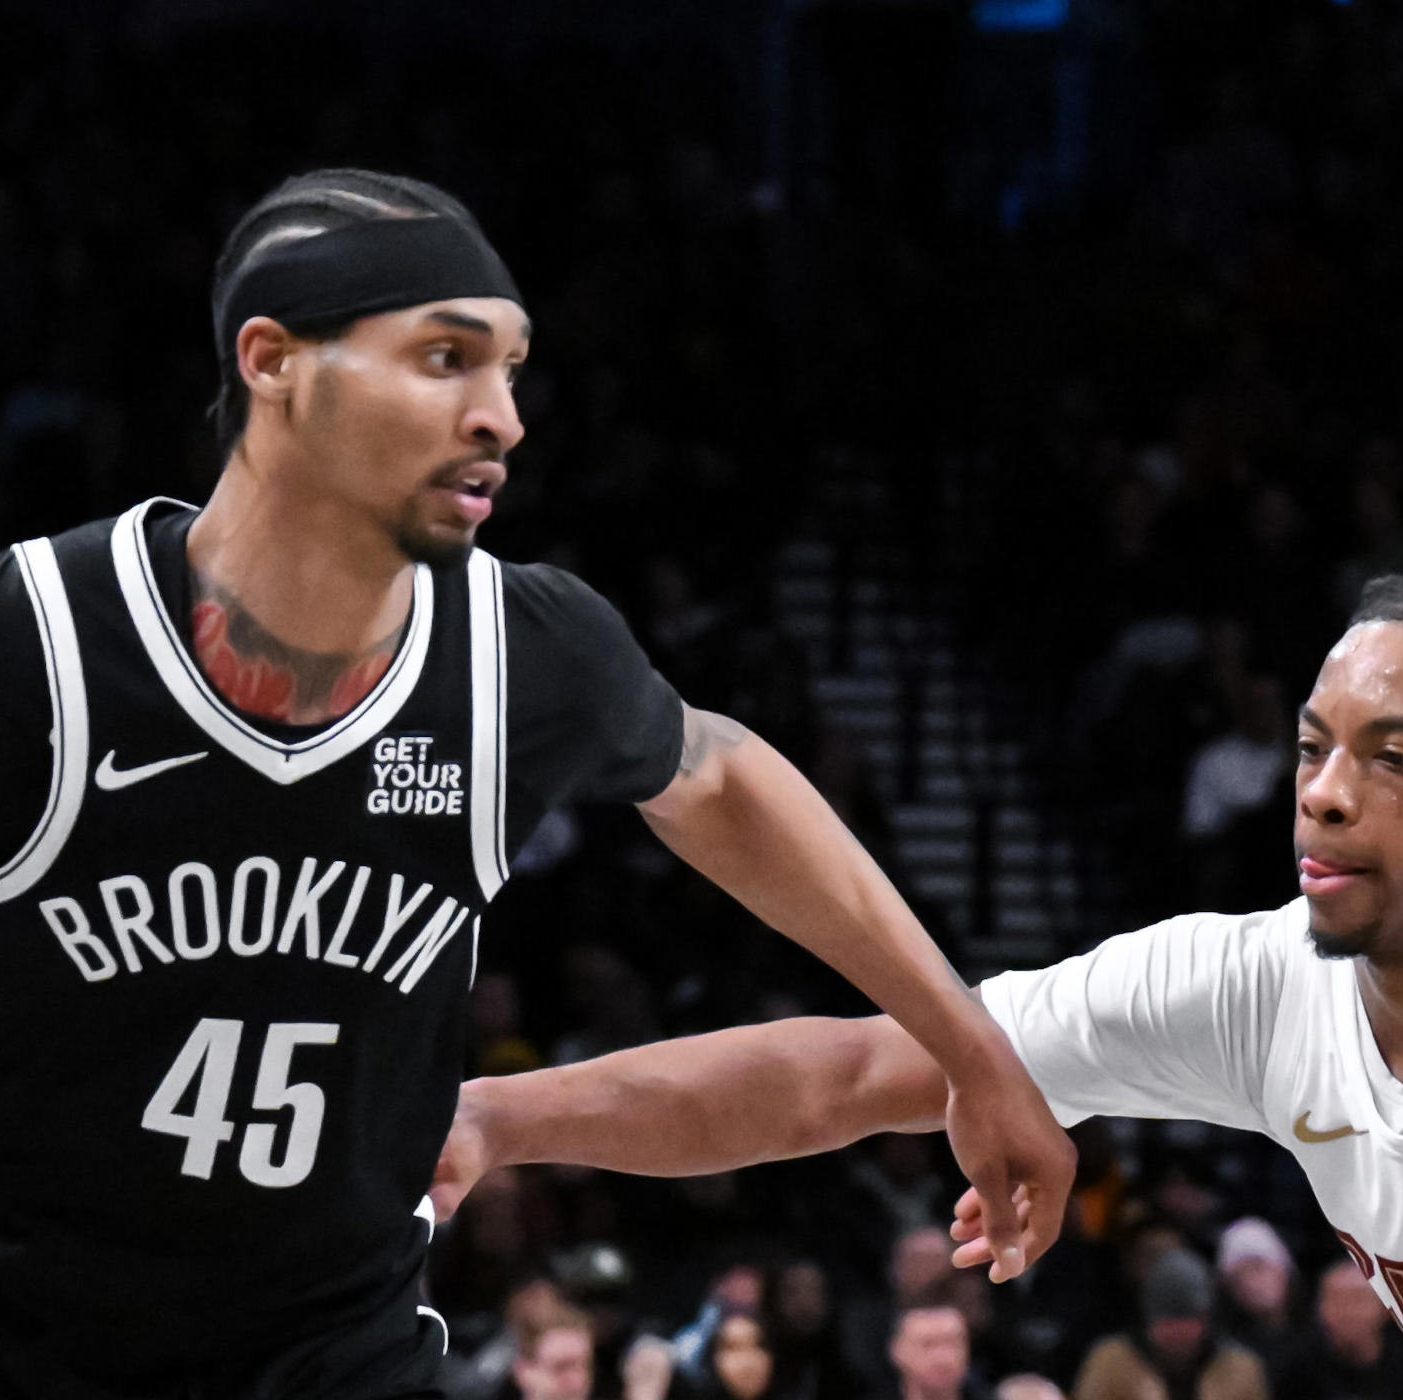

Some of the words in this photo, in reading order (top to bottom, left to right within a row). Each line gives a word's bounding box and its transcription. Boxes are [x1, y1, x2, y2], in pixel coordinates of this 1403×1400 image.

[374, 736, 434, 762] GET
[373, 763, 462, 788] YOUR
[367, 788, 465, 815] GUIDE
[38, 856, 470, 994] BROOKLYN
[140, 1017, 339, 1188] 45
